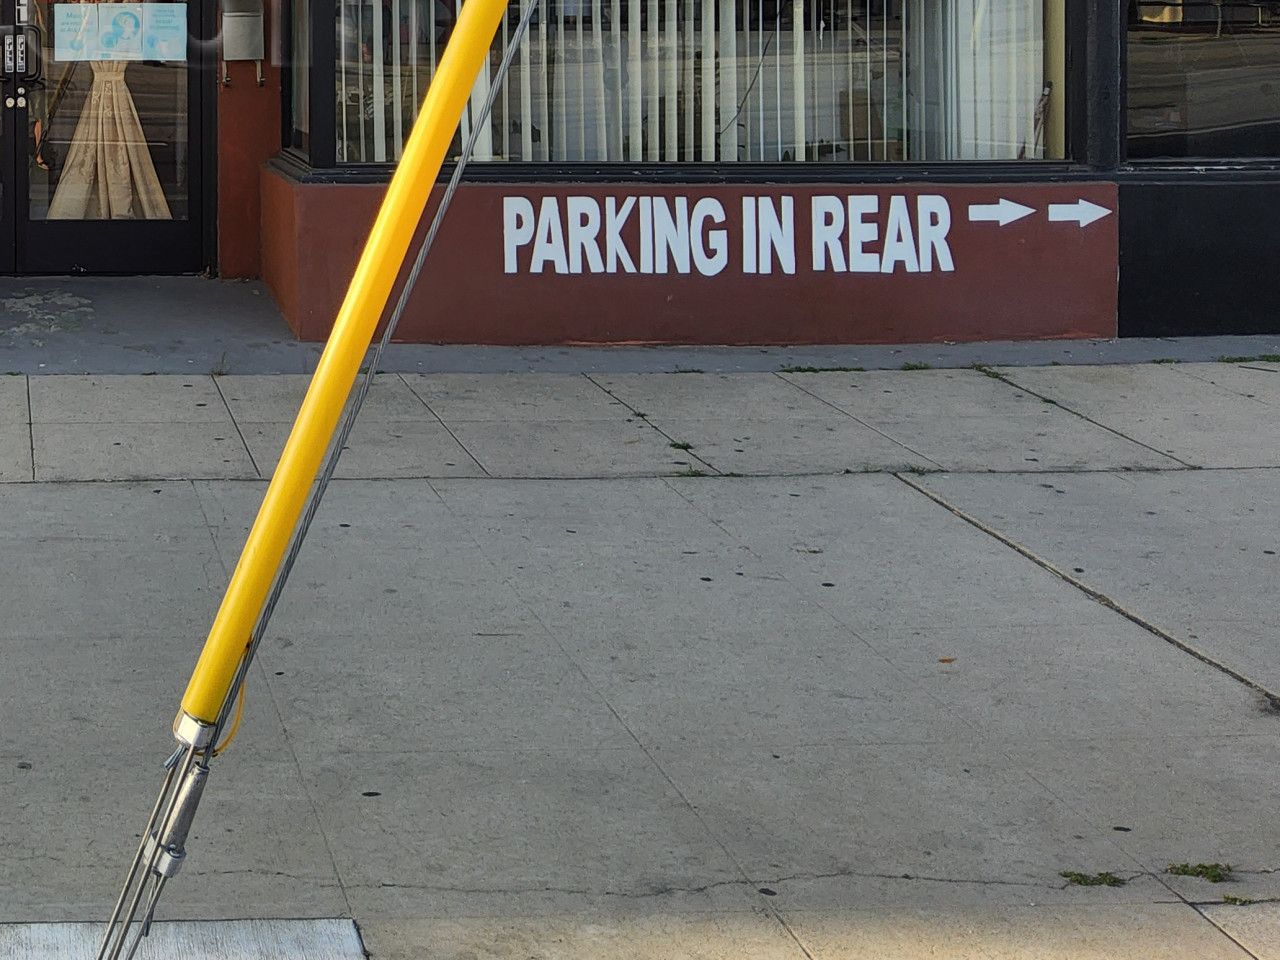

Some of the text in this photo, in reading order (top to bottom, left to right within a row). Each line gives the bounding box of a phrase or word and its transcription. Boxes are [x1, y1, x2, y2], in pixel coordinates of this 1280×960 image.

[502, 194, 955, 277] PARKING IN REAR
